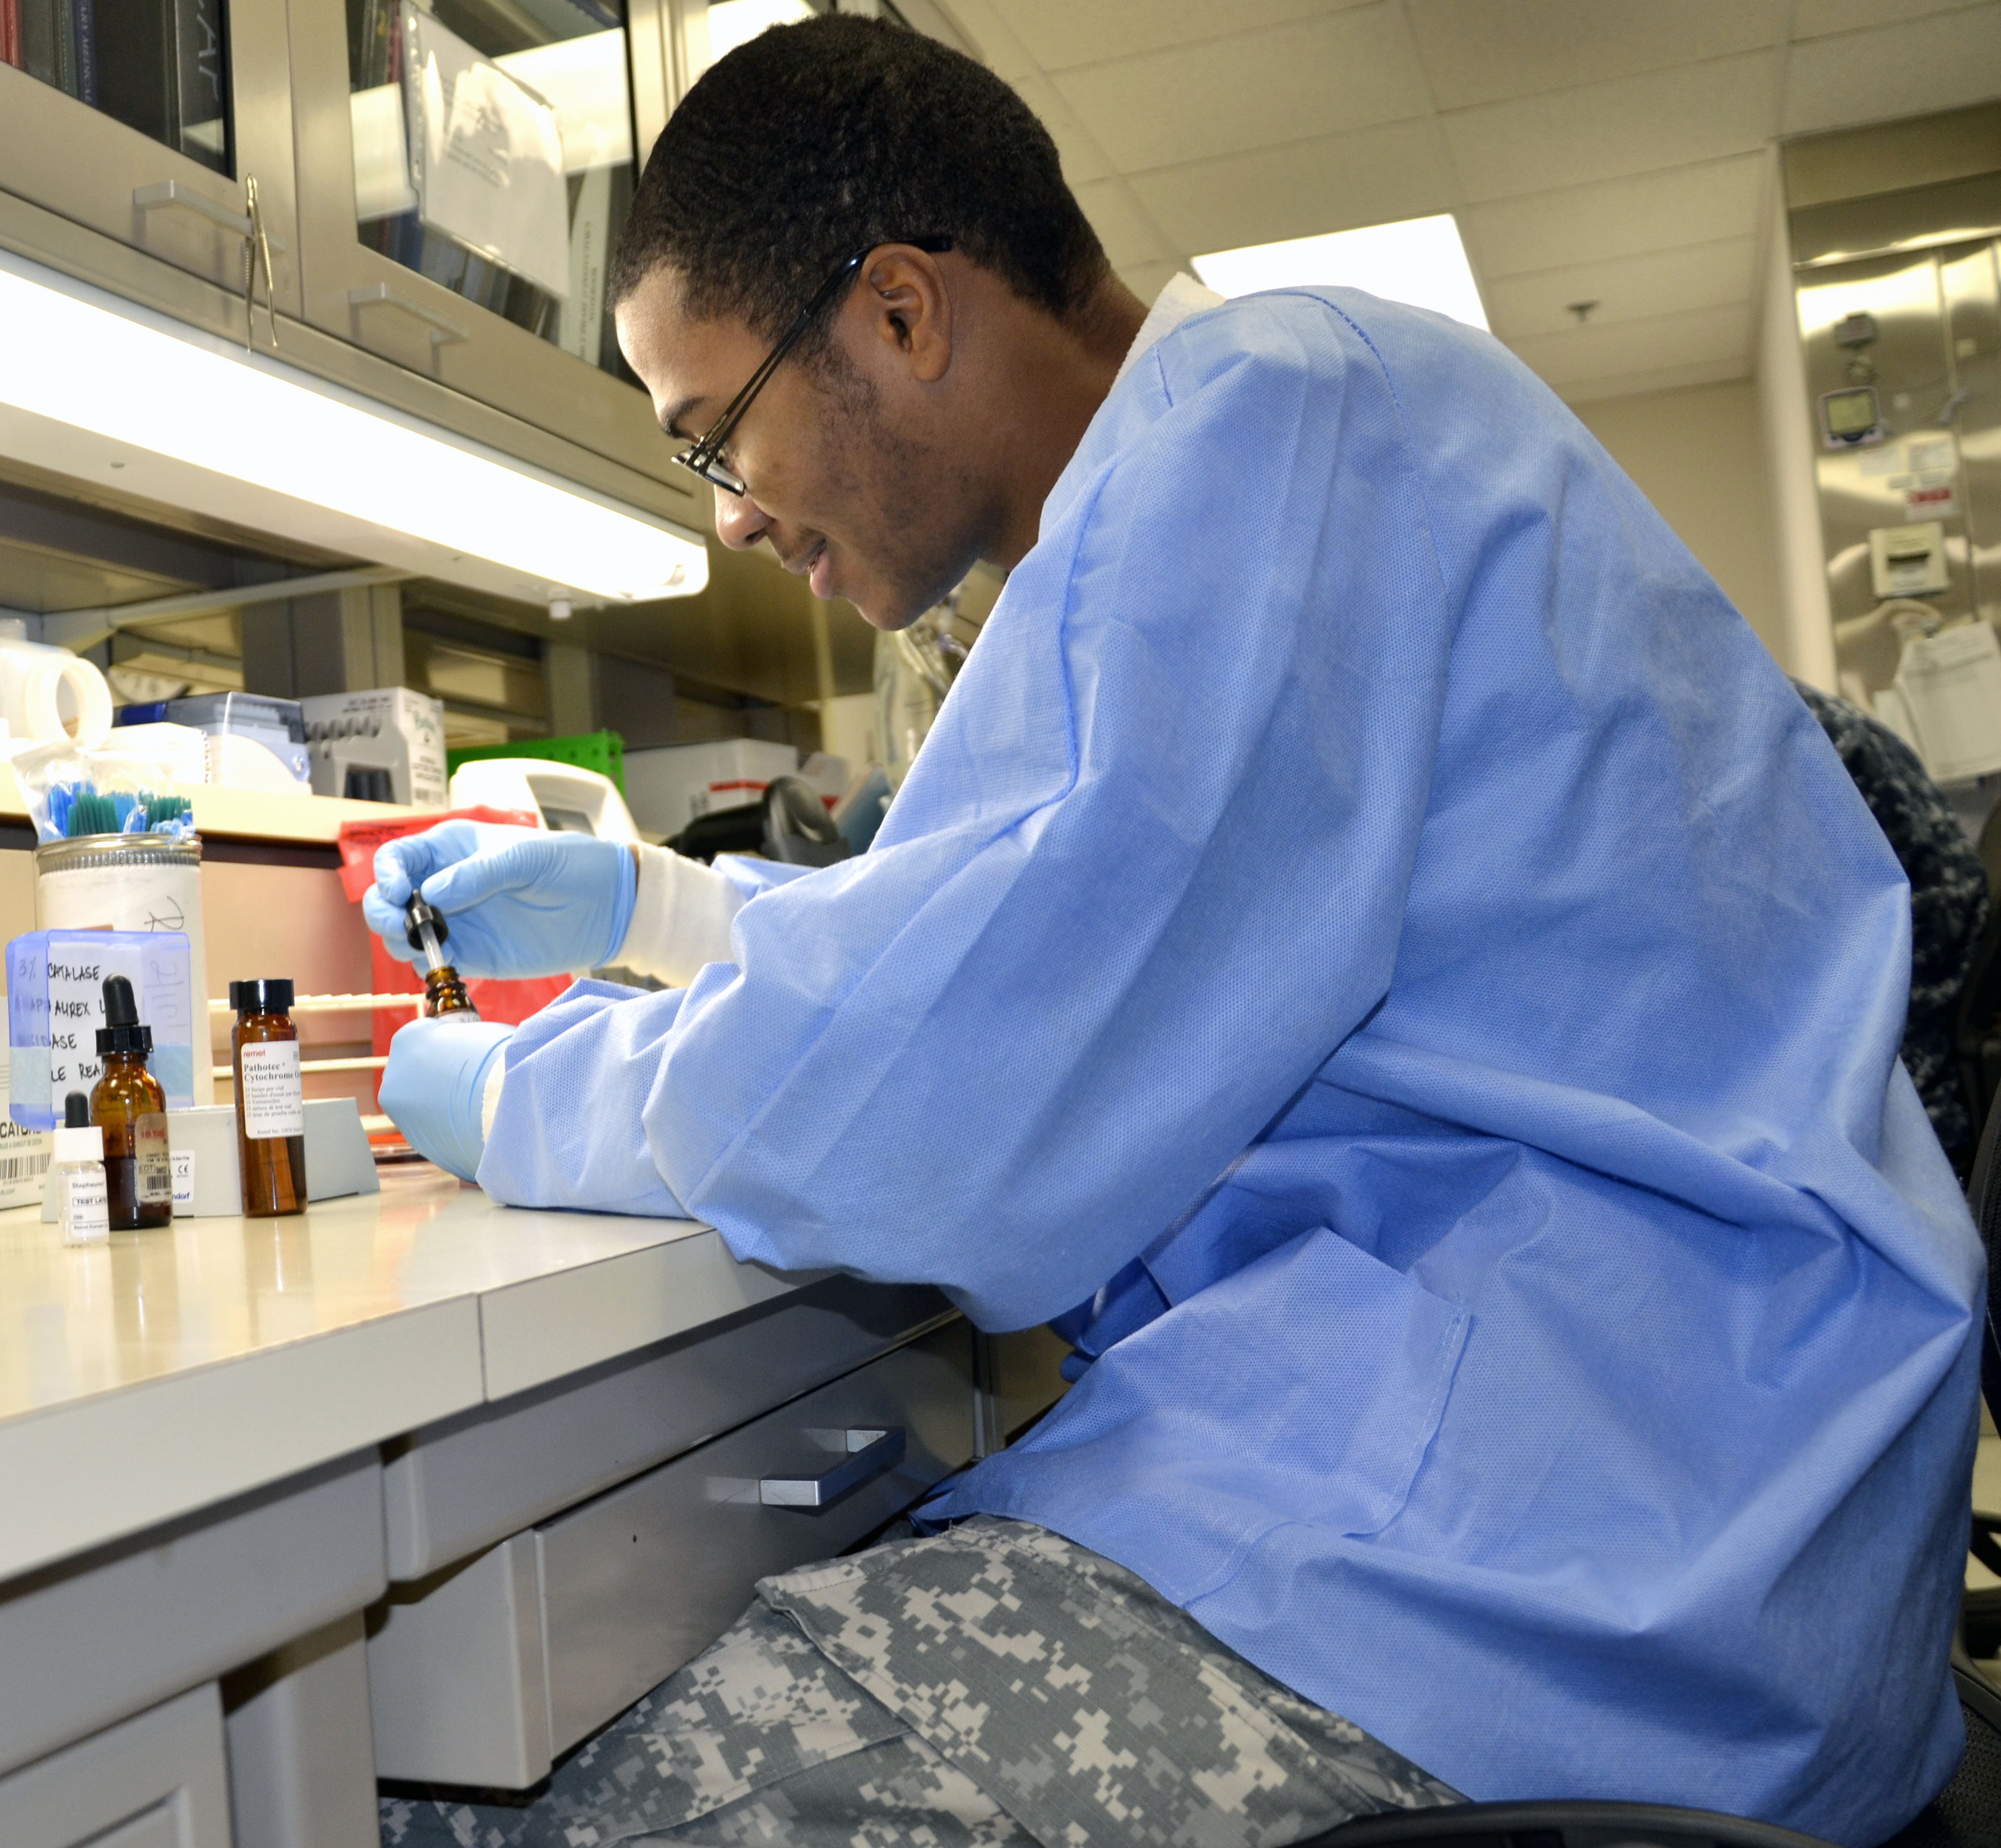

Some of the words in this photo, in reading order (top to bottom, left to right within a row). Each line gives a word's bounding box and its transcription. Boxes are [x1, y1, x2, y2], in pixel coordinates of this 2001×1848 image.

[48, 961, 100, 982] CATALASE
[244, 1049, 265, 1057] remel
[244, 1063, 280, 1071] Pathotec
[244, 1072, 293, 1083] Cytochrome
